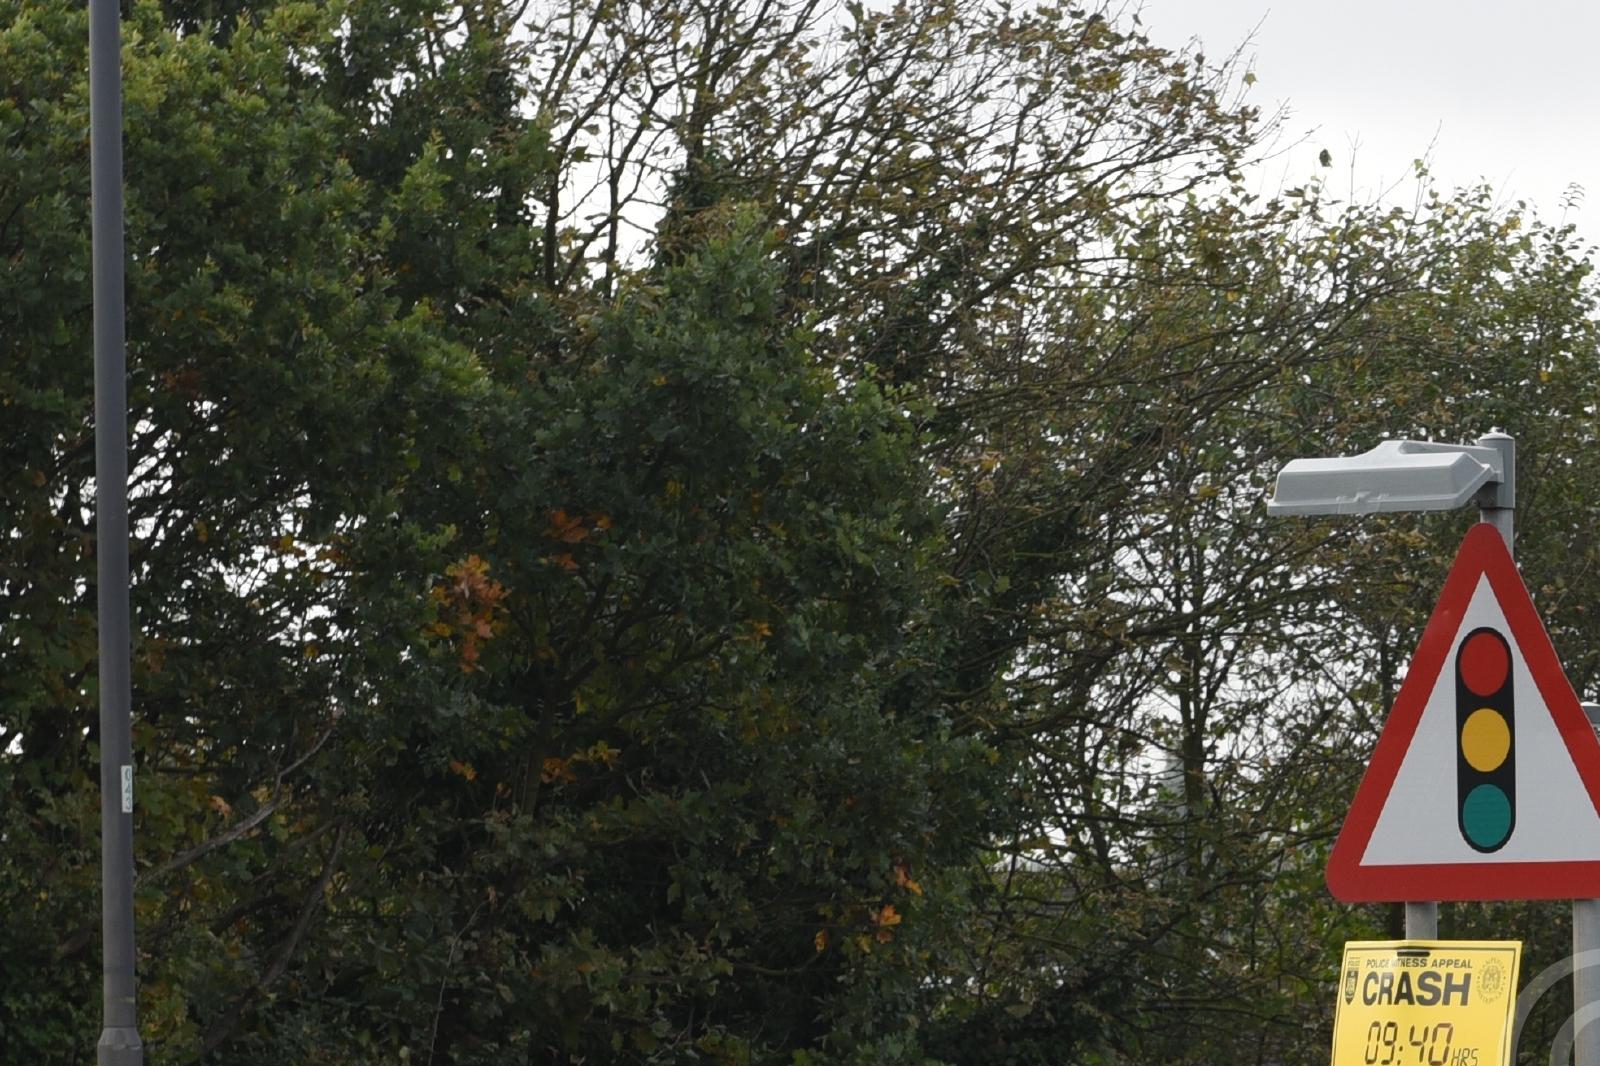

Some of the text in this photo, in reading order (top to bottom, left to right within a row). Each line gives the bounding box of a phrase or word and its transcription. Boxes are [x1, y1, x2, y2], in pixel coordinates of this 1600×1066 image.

[1365, 958, 1390, 968] POLICE
[1391, 957, 1428, 968] ITNESS
[1431, 958, 1473, 969] APPEAL
[1362, 970, 1472, 1006] CRASH
[1364, 1021, 1454, 1066] 09:40
